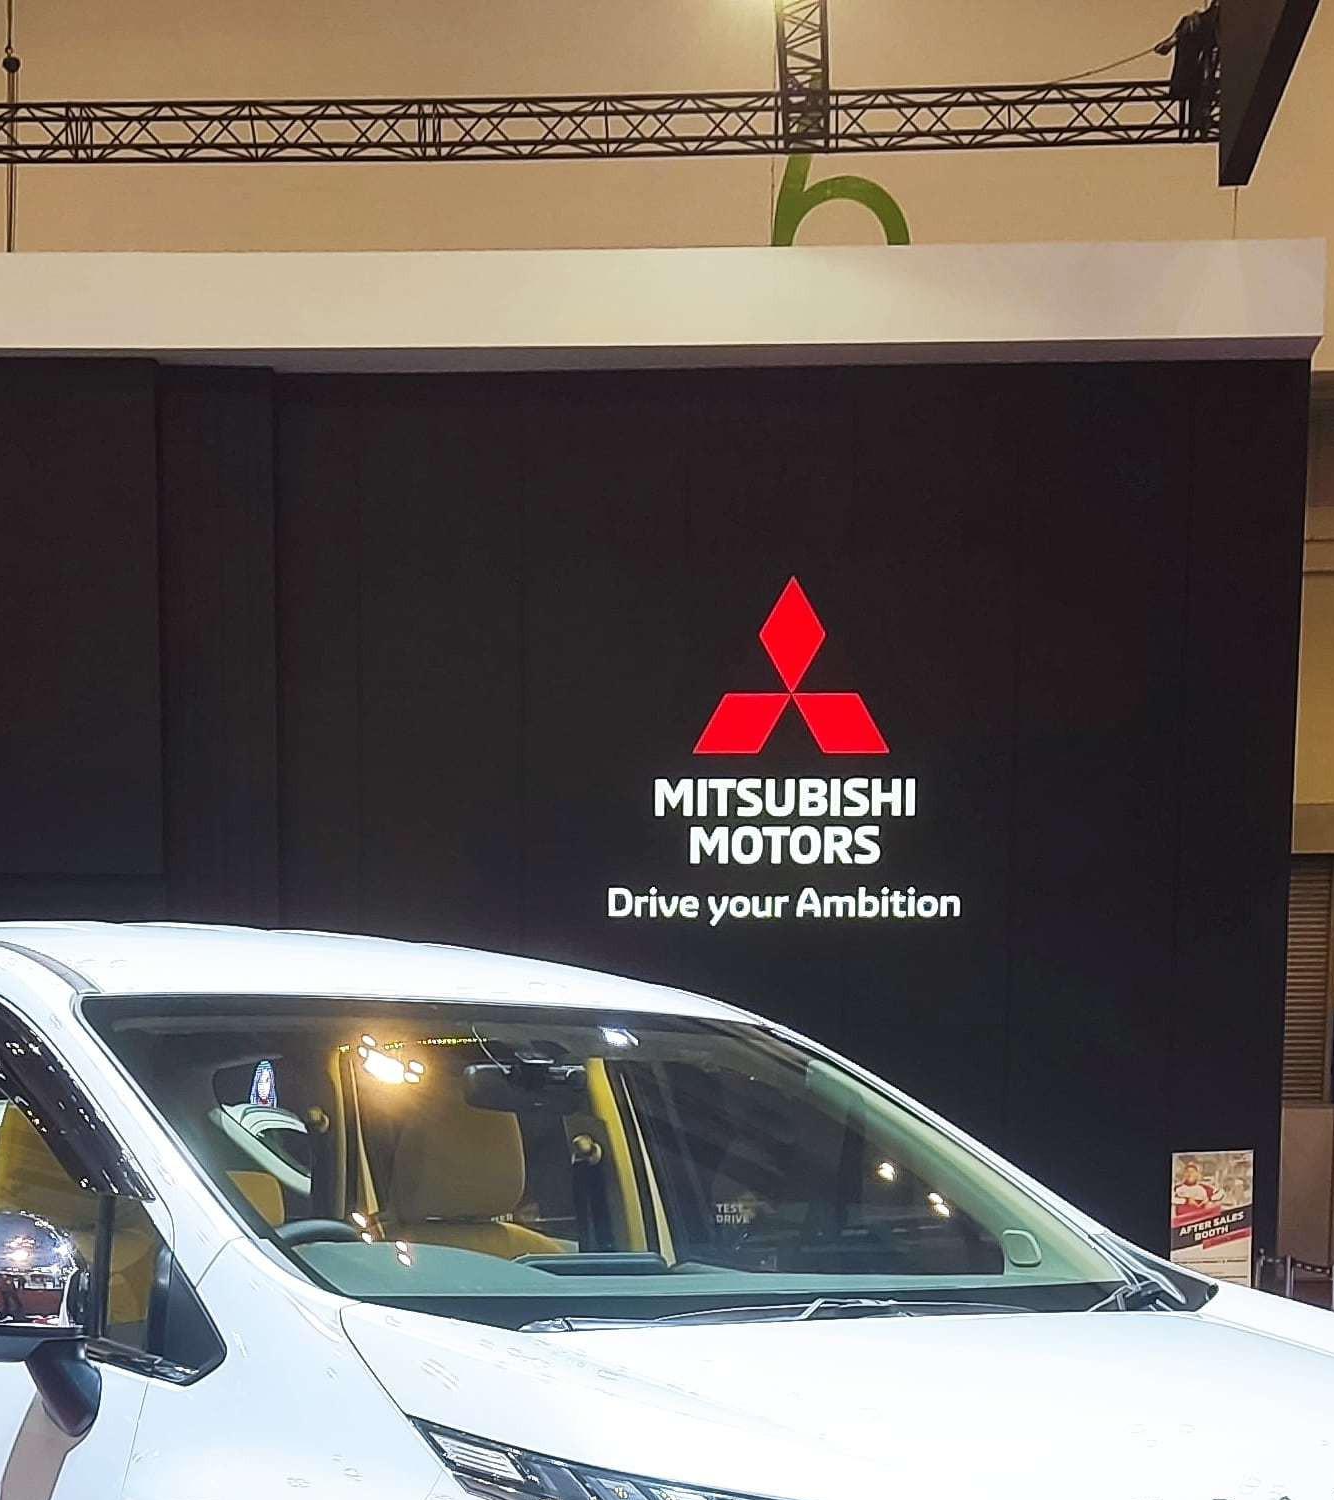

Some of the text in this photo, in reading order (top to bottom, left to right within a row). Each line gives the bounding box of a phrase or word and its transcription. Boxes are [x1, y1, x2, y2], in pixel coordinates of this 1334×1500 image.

[654, 778, 917, 817] MITSUBISHI
[689, 826, 882, 865] MOTORS
[607, 886, 962, 927] Drive your Ambition
[1179, 1210, 1244, 1237] AFTER SALES
[1194, 1224, 1229, 1242] BOOTH
